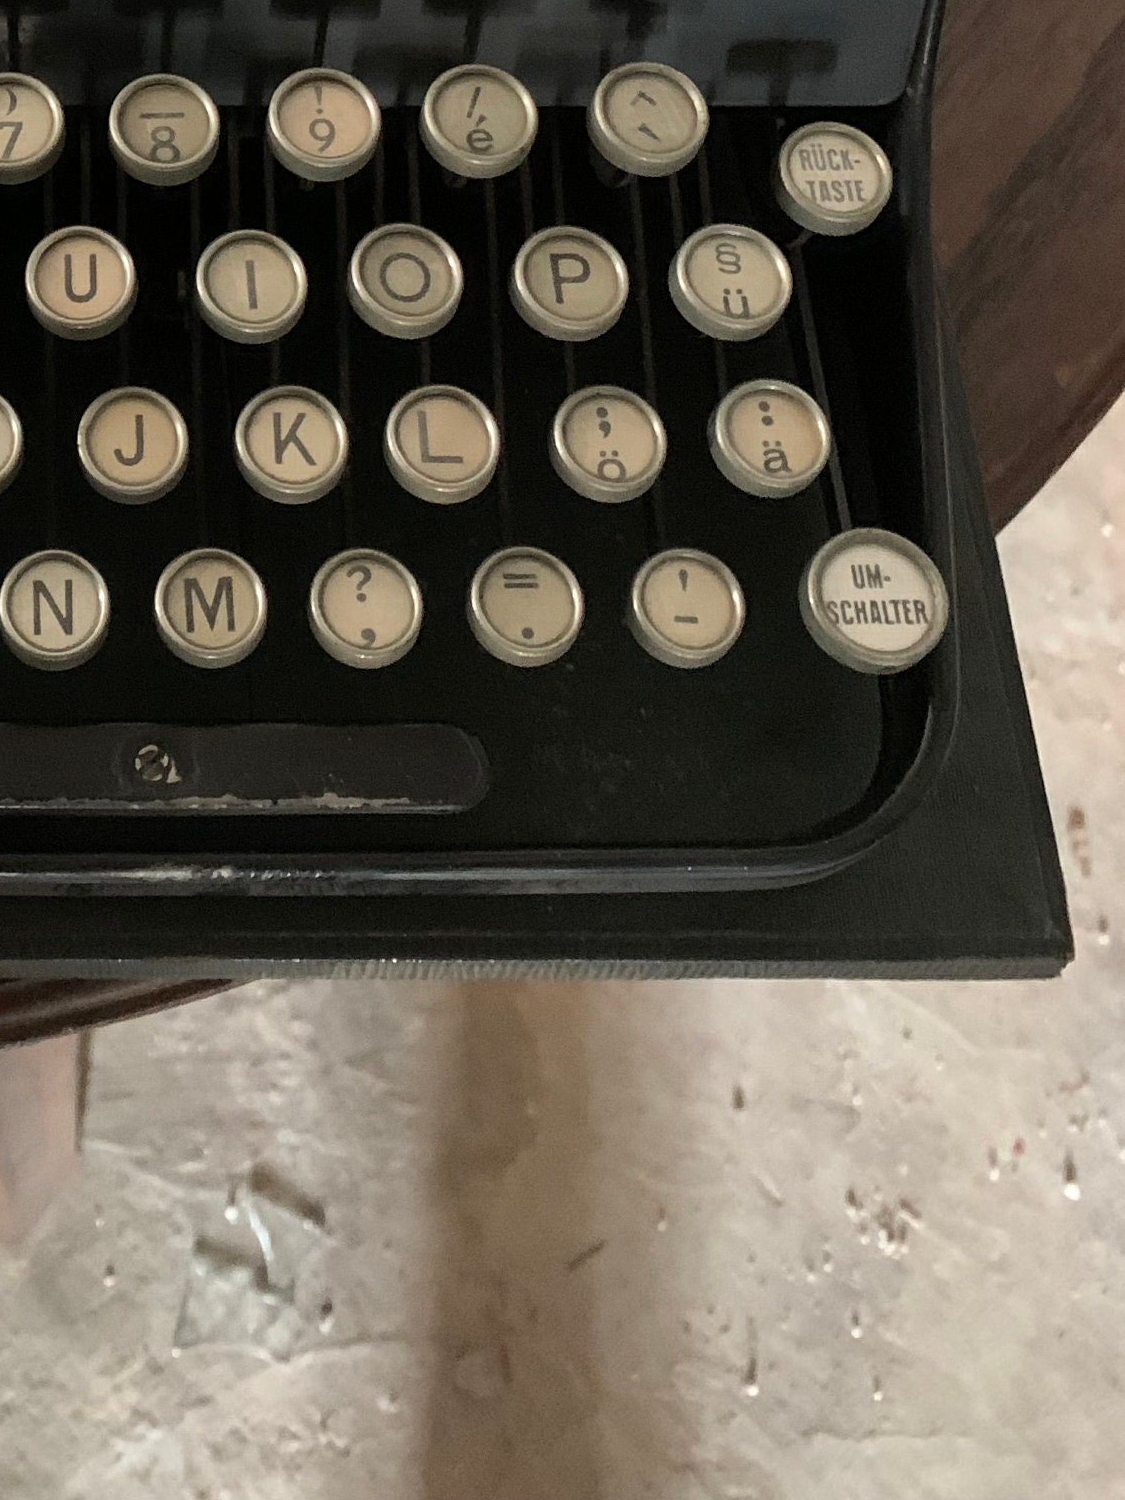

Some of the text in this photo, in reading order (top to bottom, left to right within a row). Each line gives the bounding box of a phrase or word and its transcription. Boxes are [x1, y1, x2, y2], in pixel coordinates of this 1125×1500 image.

[148, 125, 181, 164] 8
[308, 118, 337, 154] 9
[466, 114, 495, 154] é
[799, 143, 861, 172] RÜCK-
[806, 180, 866, 202] TASTE
[63, 254, 98, 303] U
[245, 260, 258, 310] I
[379, 252, 432, 303] O
[549, 253, 591, 304] P
[722, 288, 750, 321] ü
[113, 414, 144, 467] J
[274, 412, 317, 466] K
[417, 411, 464, 464] L
[762, 440, 792, 474] ä
[597, 449, 627, 484] ö
[346, 564, 372, 603] ?
[850, 564, 891, 590] UM-
[32, 578, 74, 636] N
[184, 576, 236, 634] M
[826, 600, 928, 626] SCHALTER
